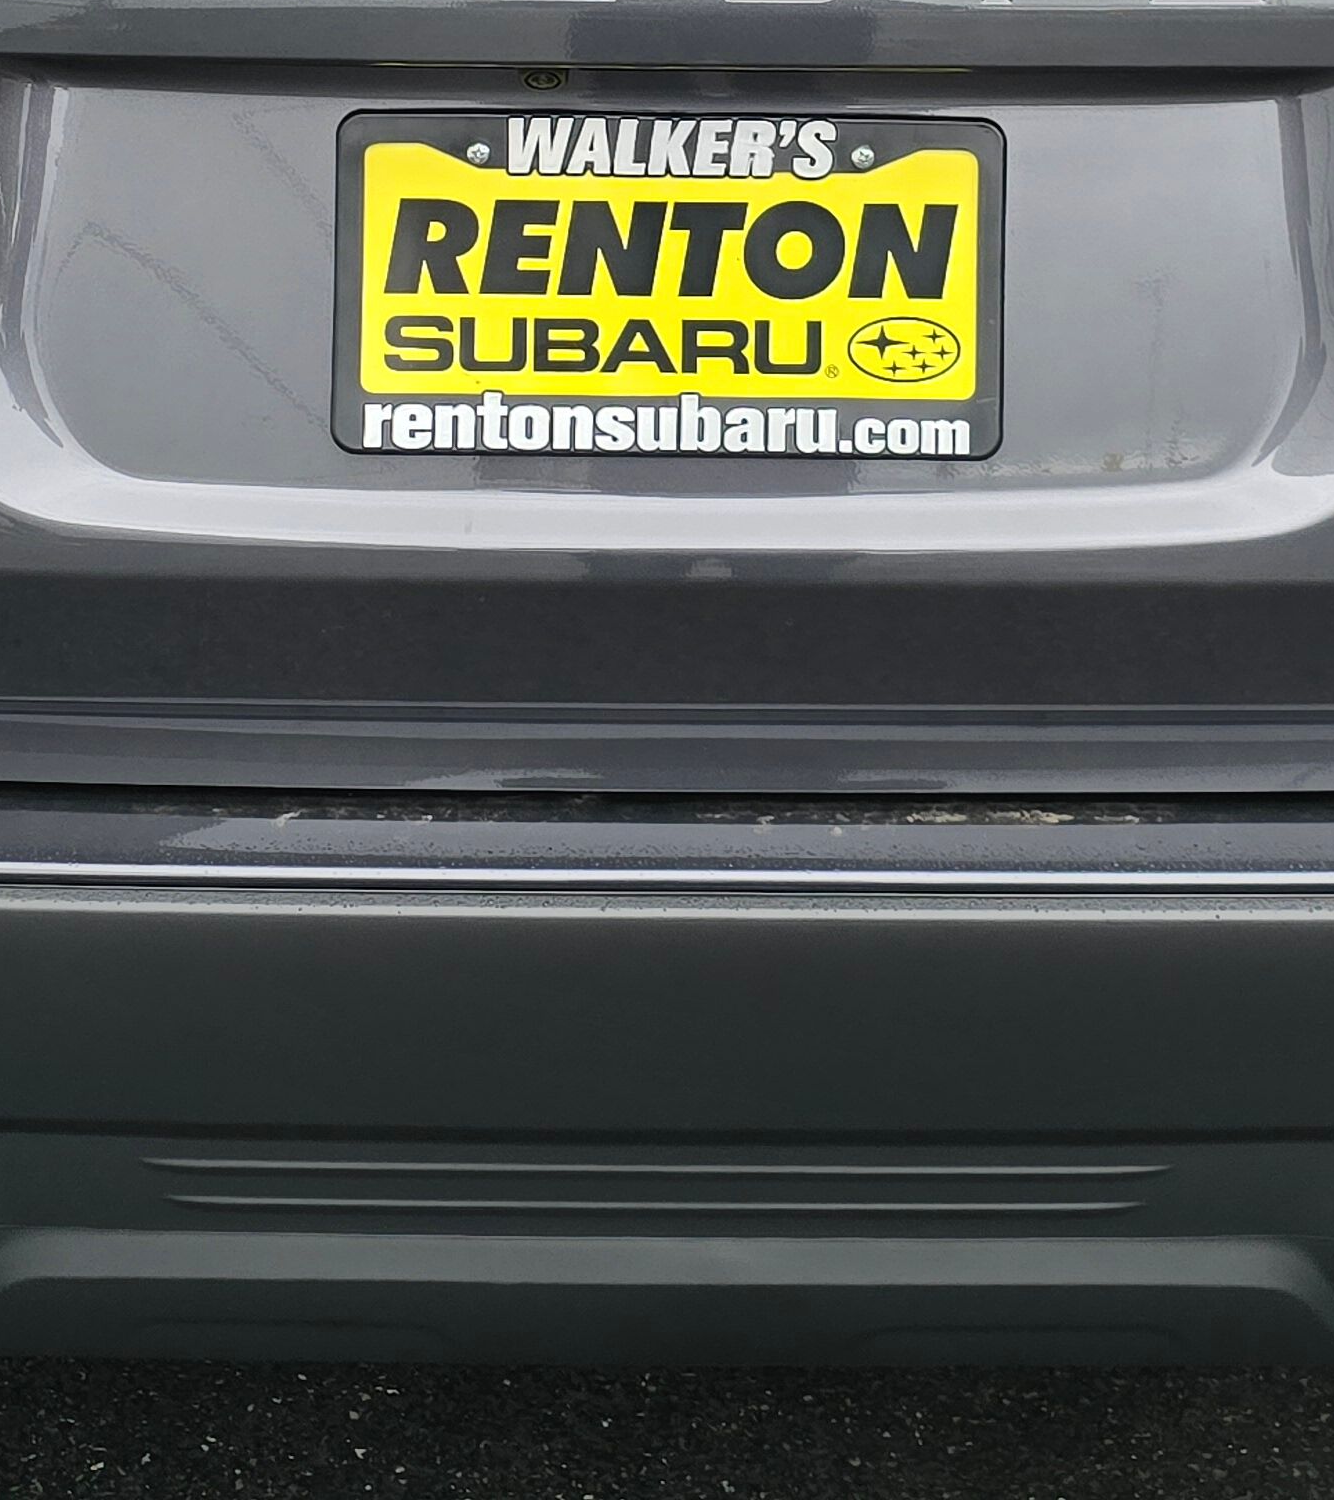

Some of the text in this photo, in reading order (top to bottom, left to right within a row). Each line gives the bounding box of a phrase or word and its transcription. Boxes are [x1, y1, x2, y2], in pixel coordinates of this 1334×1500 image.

[506, 116, 837, 180] WALKER'S
[383, 197, 959, 300] RENTON
[363, 390, 970, 456] rentonsubaru.com
